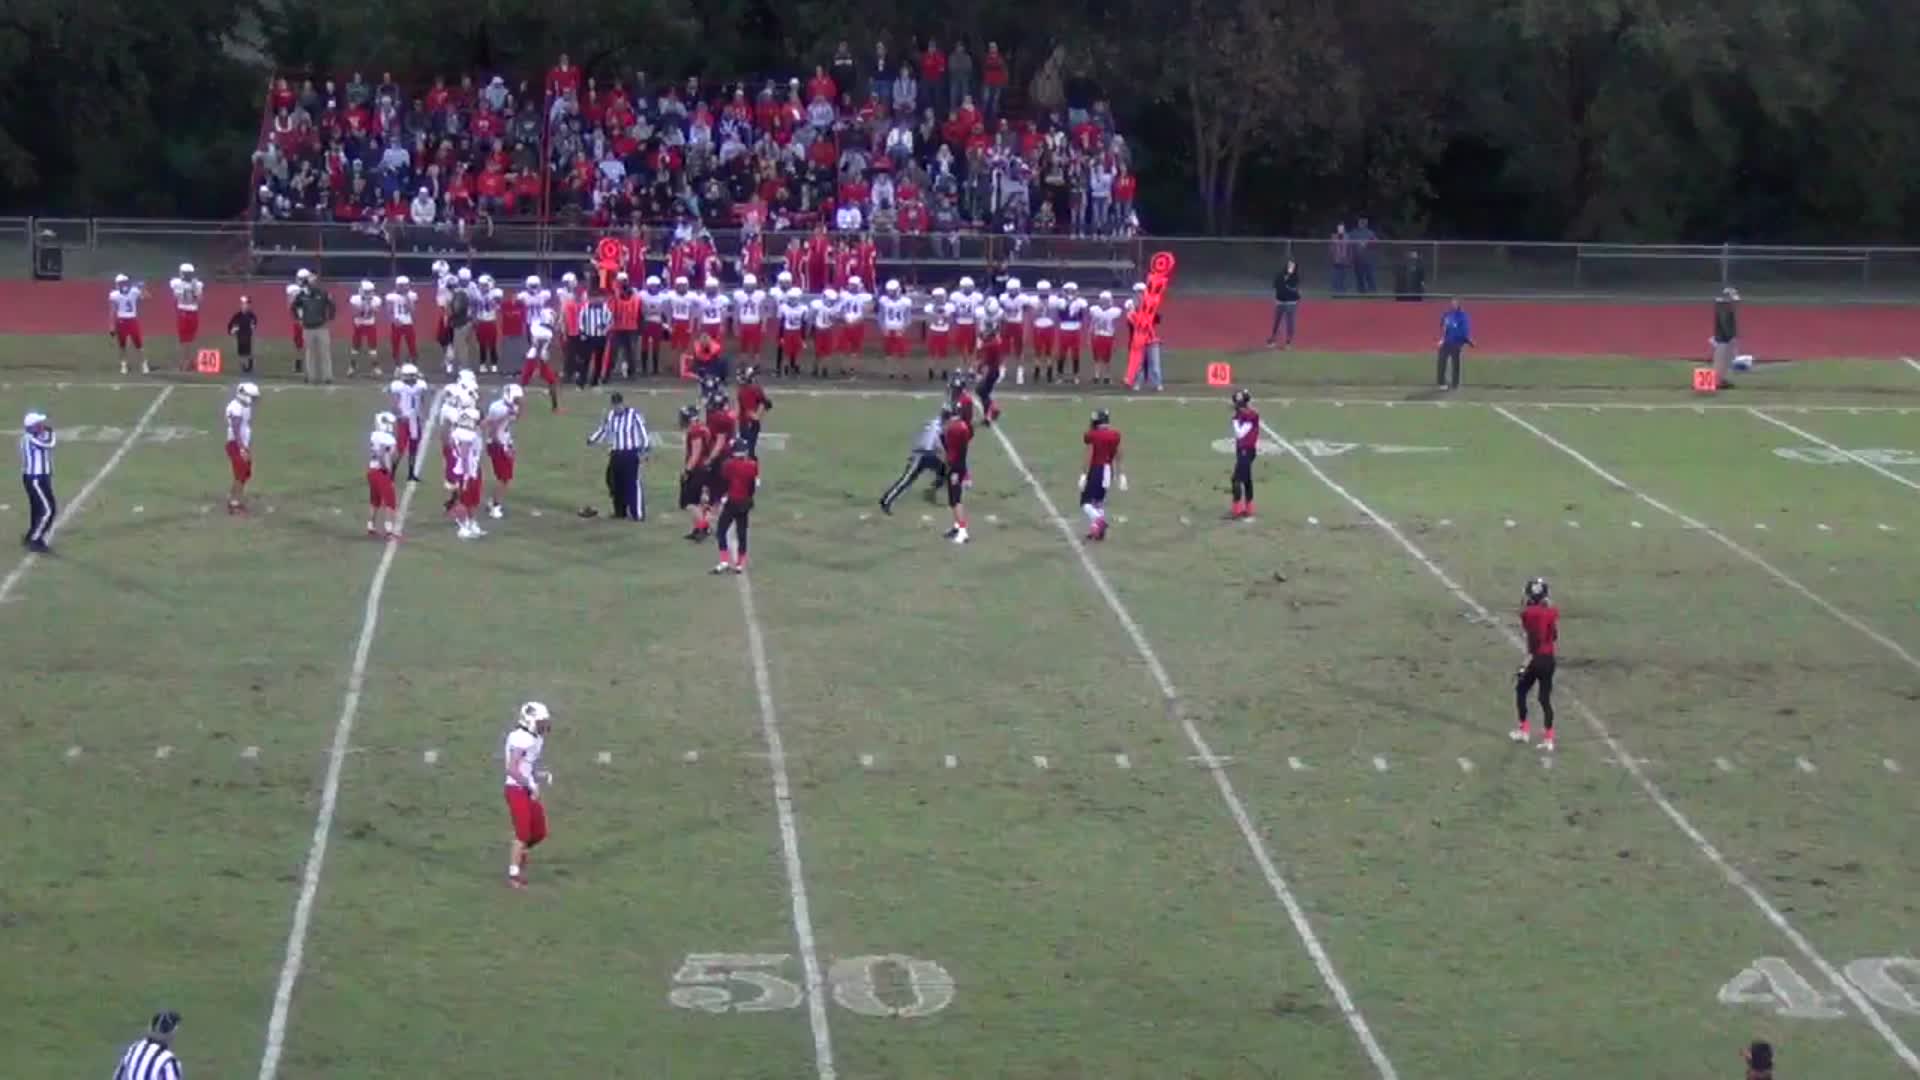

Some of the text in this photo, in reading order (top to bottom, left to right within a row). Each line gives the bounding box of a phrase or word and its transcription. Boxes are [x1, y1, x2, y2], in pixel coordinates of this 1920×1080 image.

[200, 351, 217, 369] 40
[1211, 365, 1227, 381] 40
[669, 953, 955, 1018] 50
[1716, 956, 1920, 1018] 40
